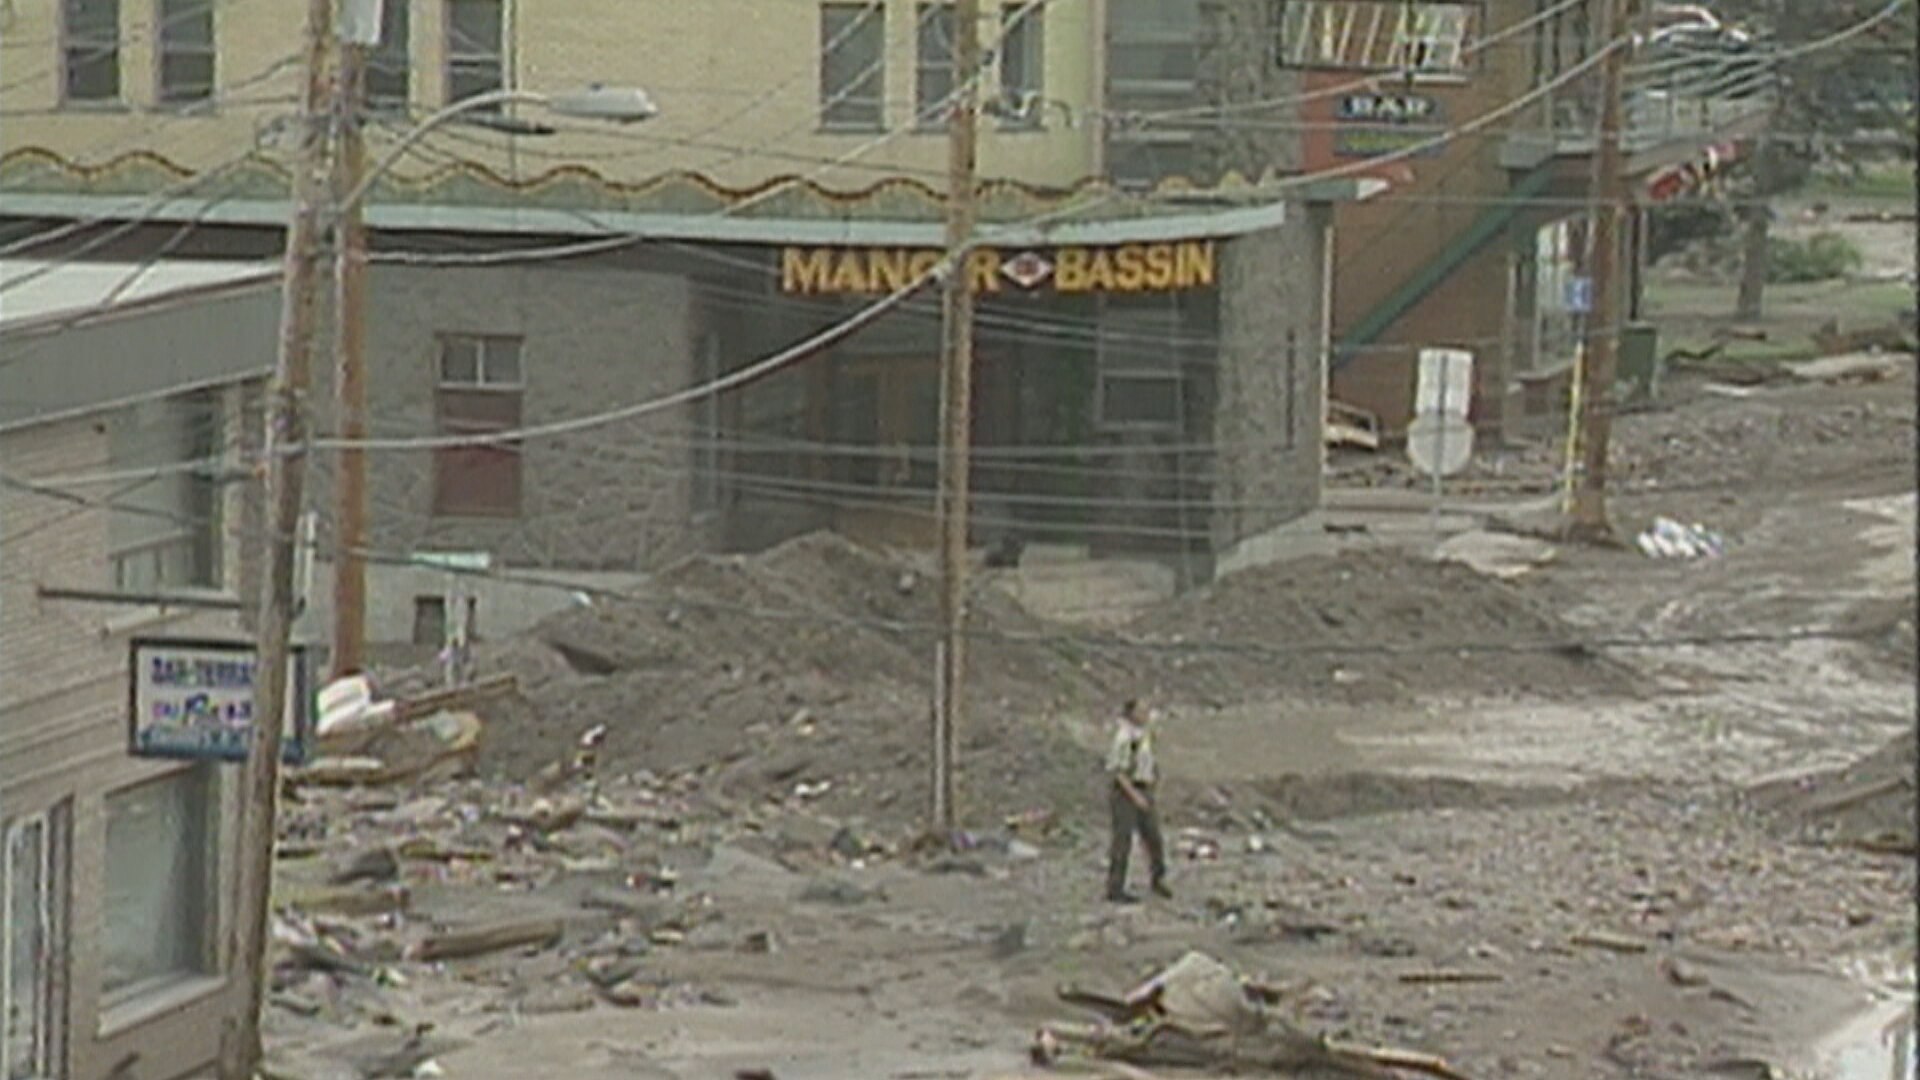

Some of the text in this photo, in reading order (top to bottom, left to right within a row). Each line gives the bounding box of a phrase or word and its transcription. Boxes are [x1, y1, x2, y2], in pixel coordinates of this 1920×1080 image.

[1351, 95, 1428, 118] BAR
[783, 242, 1214, 291] MANOR BASSIN
